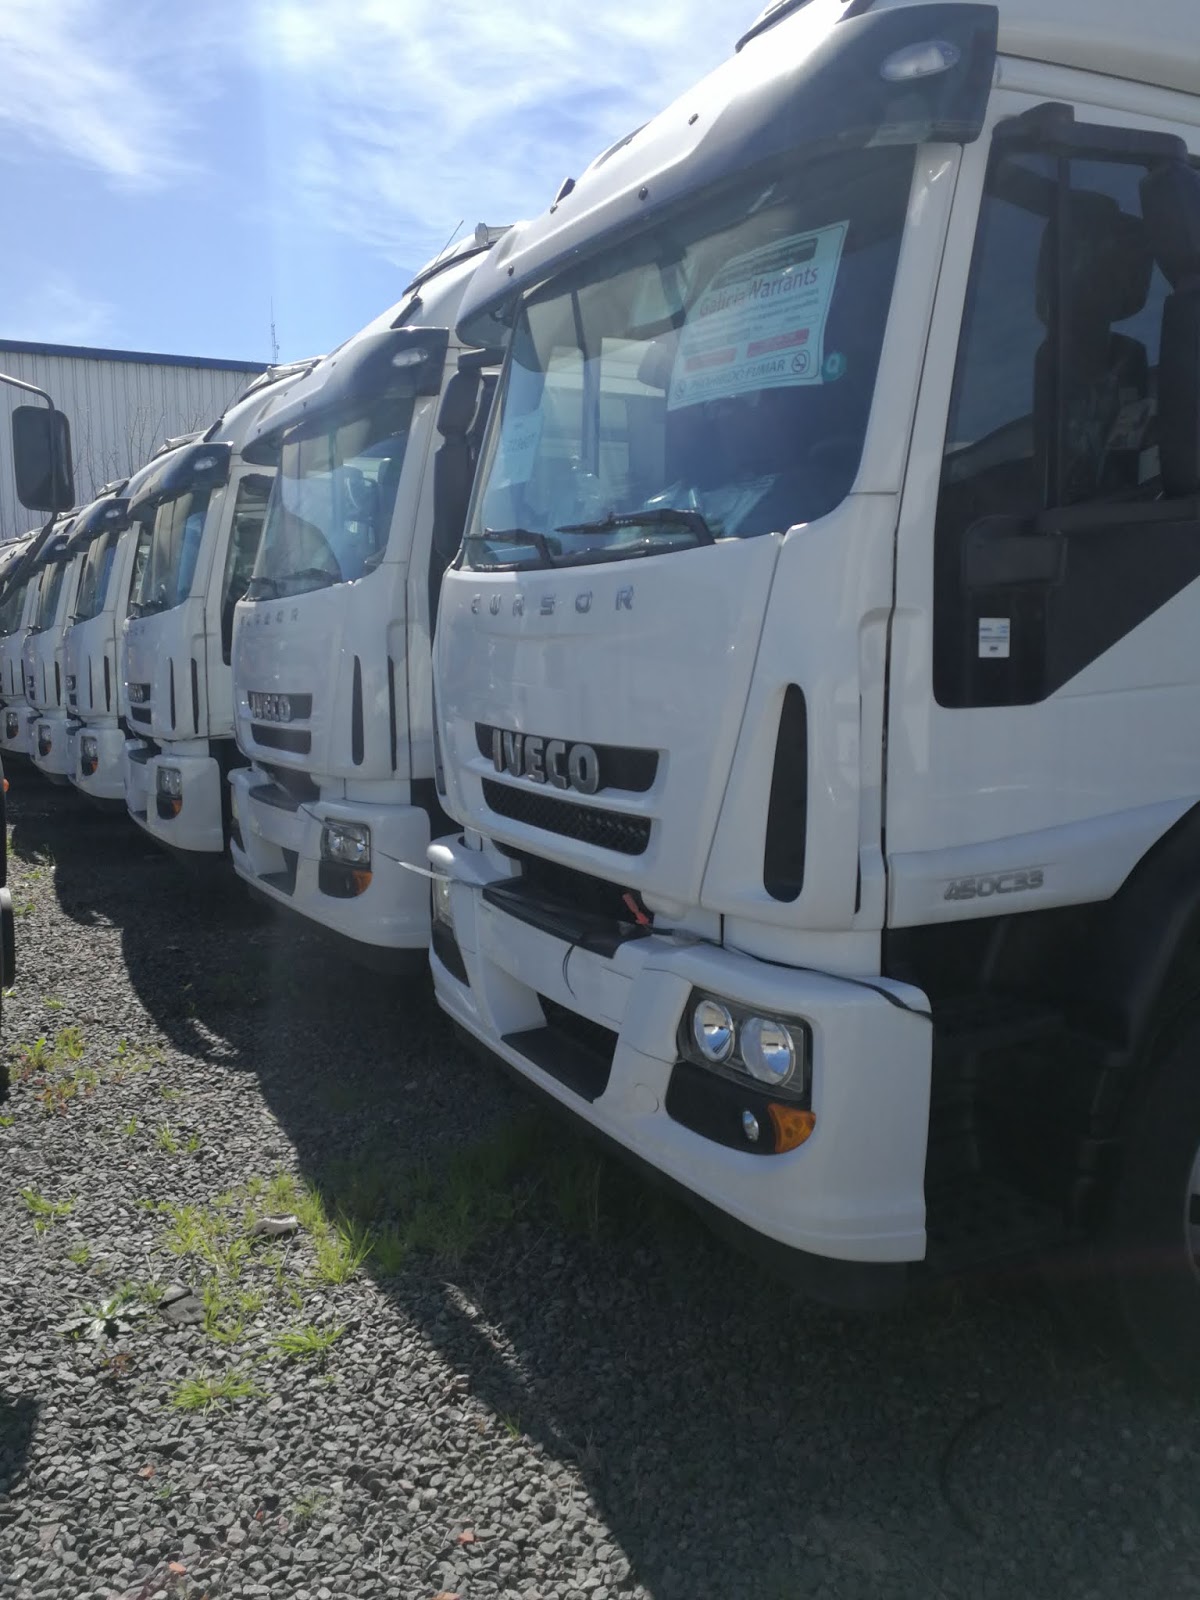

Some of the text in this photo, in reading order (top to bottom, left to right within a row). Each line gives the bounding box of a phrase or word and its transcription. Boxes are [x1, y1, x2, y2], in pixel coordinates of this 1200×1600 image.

[749, 266, 820, 300] Warrants
[470, 585, 634, 616] CURSOR
[251, 693, 291, 722] IVECO
[492, 728, 600, 795] IVECO
